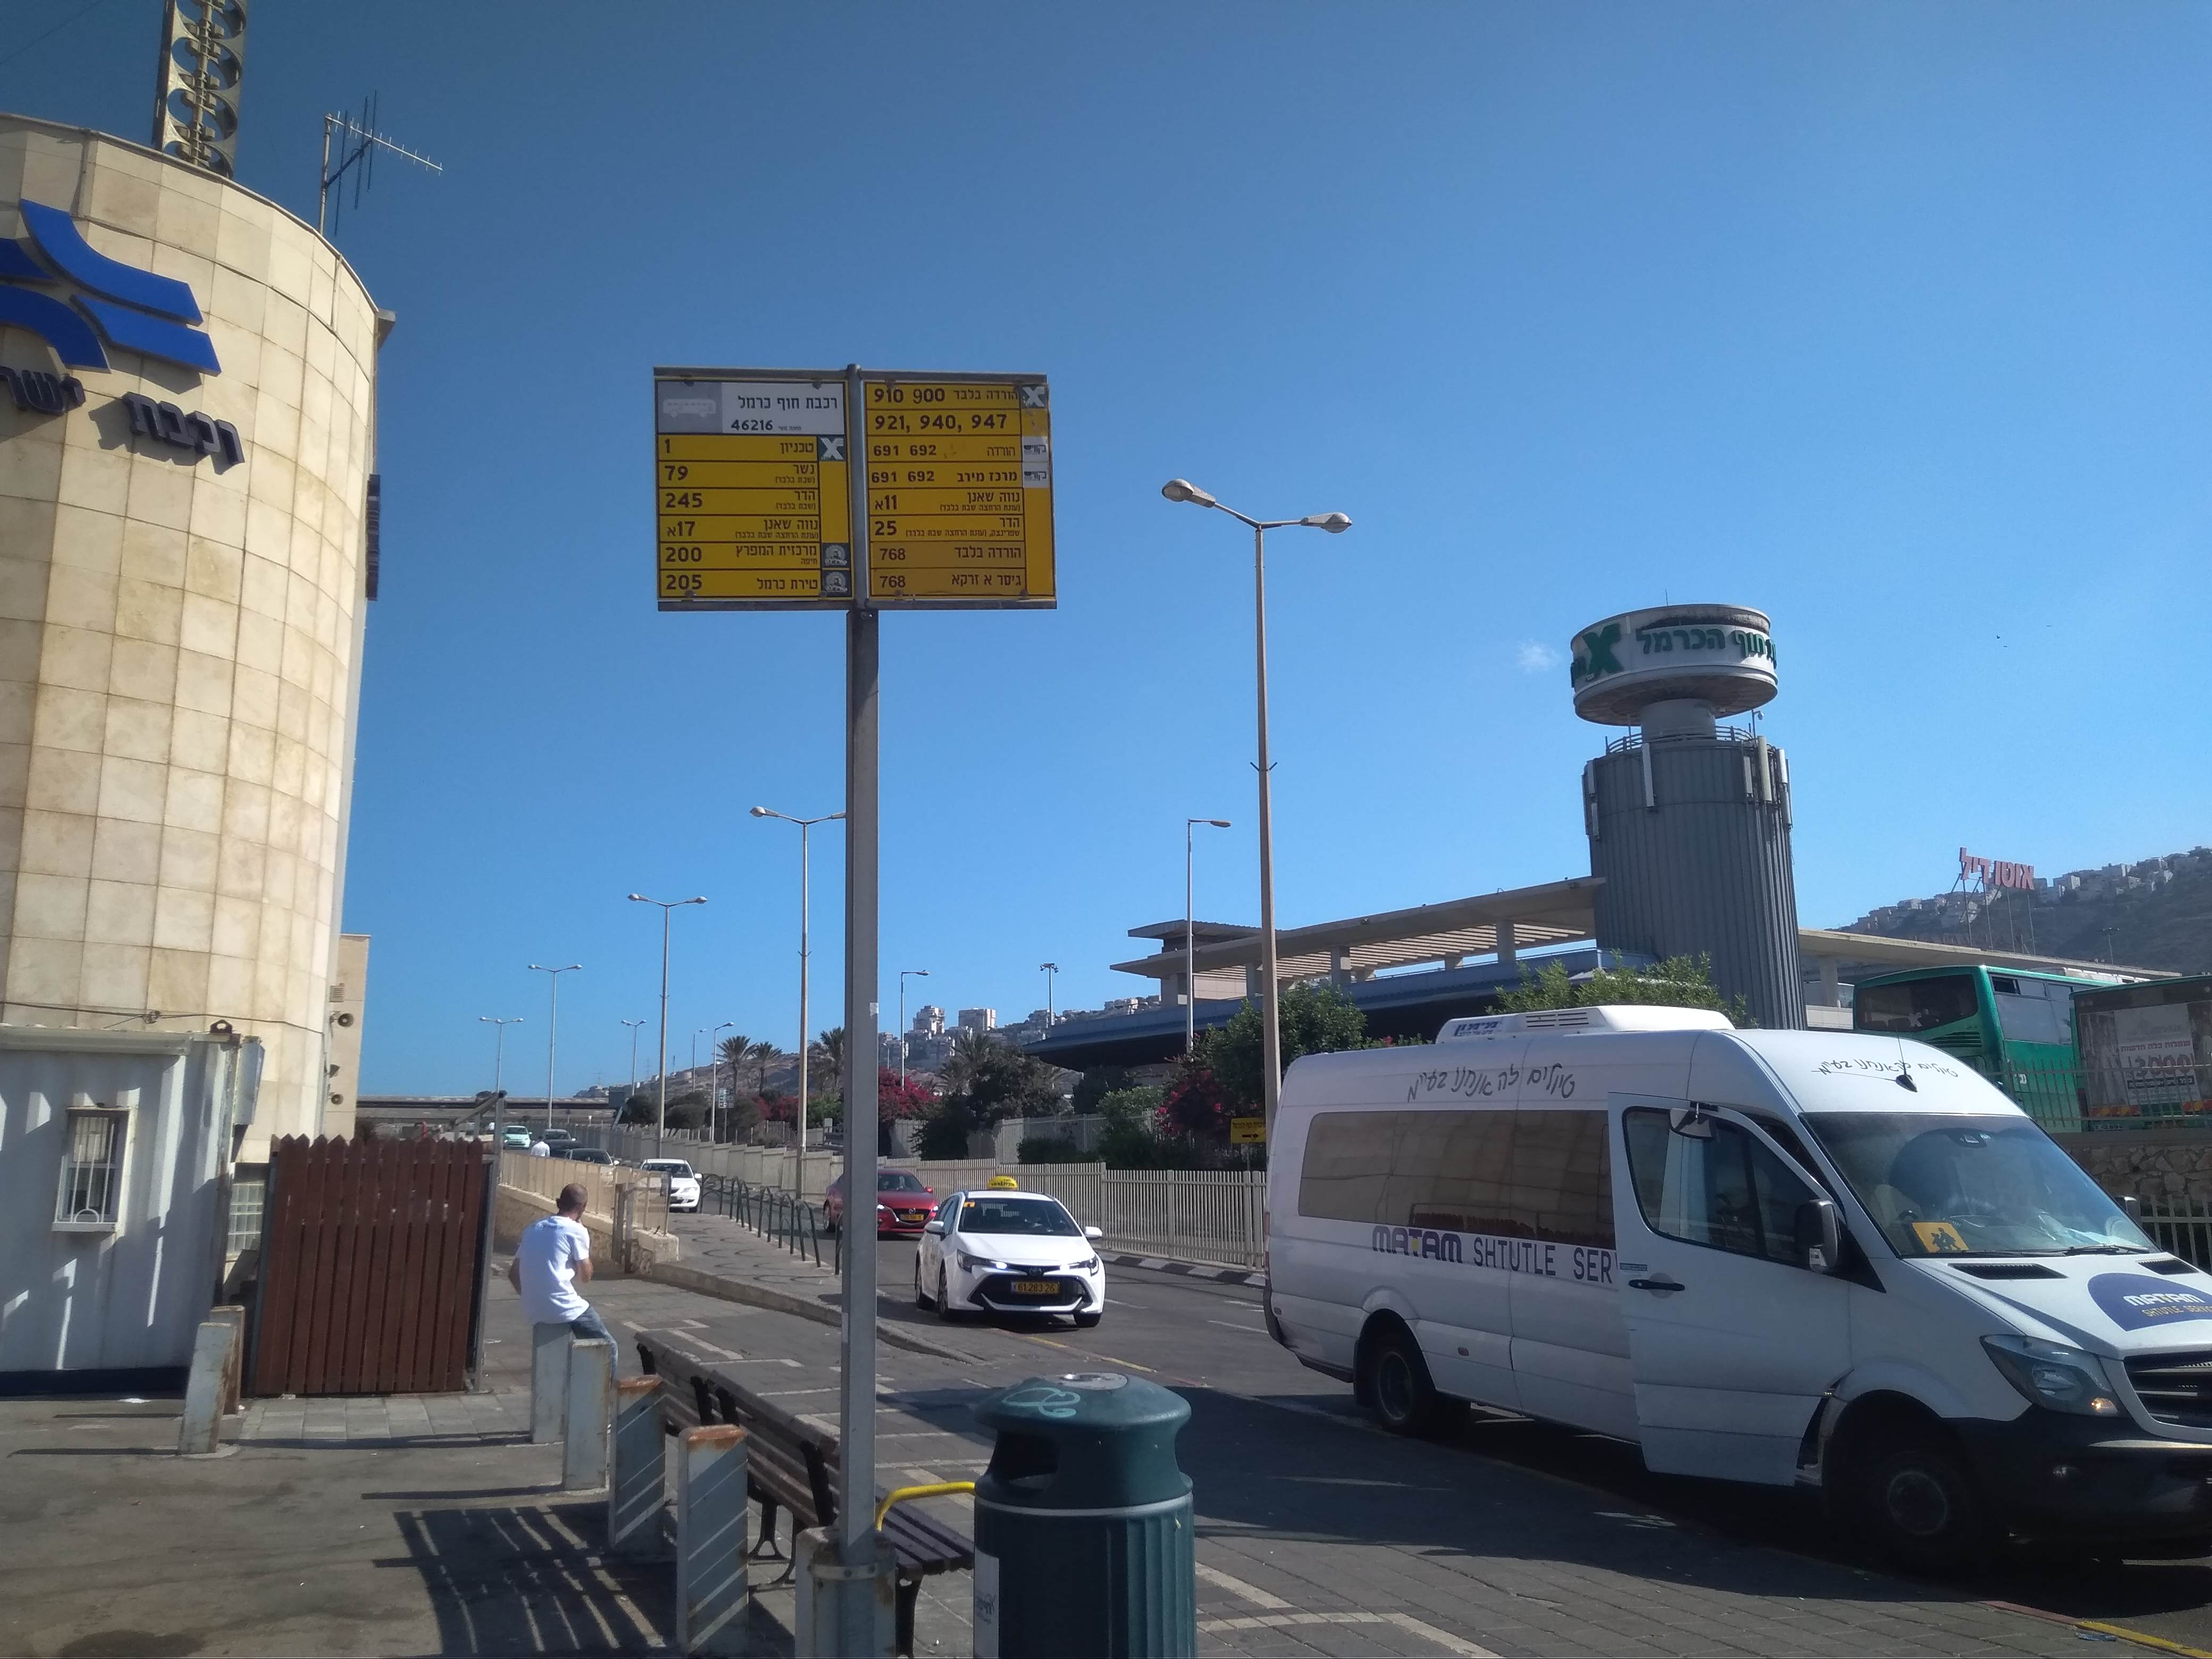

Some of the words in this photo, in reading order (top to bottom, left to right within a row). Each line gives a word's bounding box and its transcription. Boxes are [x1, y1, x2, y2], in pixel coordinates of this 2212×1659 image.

[874, 388, 904, 403] 910
[913, 388, 945, 404] 900
[954, 389, 981, 400] בלבד
[986, 390, 1017, 400] הורדה
[738, 395, 771, 409] כרמל
[777, 397, 799, 410] חוף
[806, 397, 838, 409] רכבת
[123, 392, 245, 466] רכבת
[731, 419, 773, 431] 46216
[875, 414, 911, 433] 921,
[920, 414, 963, 433] 940,
[971, 414, 1008, 429] 947
[665, 439, 671, 454] 1
[780, 442, 814, 455] טכניון
[874, 445, 899, 457] 691
[910, 445, 937, 456] 692
[987, 446, 1016, 457] הורדה
[665, 465, 689, 481] 79
[793, 464, 815, 474] נשר
[872, 472, 898, 484] 691
[908, 471, 935, 483] 692
[958, 471, 985, 483] מירב
[989, 471, 1018, 482] מרכז
[665, 492, 703, 508] 245
[794, 491, 815, 501] הדר
[967, 492, 994, 504] שאנן
[999, 492, 1020, 502] נווה
[763, 518, 792, 532] שאנן
[797, 518, 818, 531] נווה
[875, 521, 898, 536] 25
[1000, 517, 1020, 527] הדר
[665, 547, 702, 563] 200
[735, 544, 774, 558] המפרץ
[778, 545, 817, 556] מרכזית
[880, 548, 906, 561] 768
[954, 546, 983, 558] בלבד
[988, 548, 1021, 558] הורדה
[666, 574, 703, 590] 205
[757, 577, 784, 590] כרמל
[790, 579, 818, 590] טירת
[880, 575, 906, 588] 768
[951, 574, 979, 586] זרקא
[984, 575, 992, 585] א
[1636, 628, 1726, 654] הכרמל
[1731, 630, 1766, 658] חוף
[1959, 846, 1992, 884] דיל
[1995, 860, 2035, 890] אוטו
[1372, 1225, 1463, 1264] MATAM
[1473, 1236, 1556, 1276] SHTUTLE
[1573, 1247, 1618, 1284] SER
[2123, 1293, 2206, 1306] MATAM
[2141, 1305, 2184, 1317] SHTUTLE
